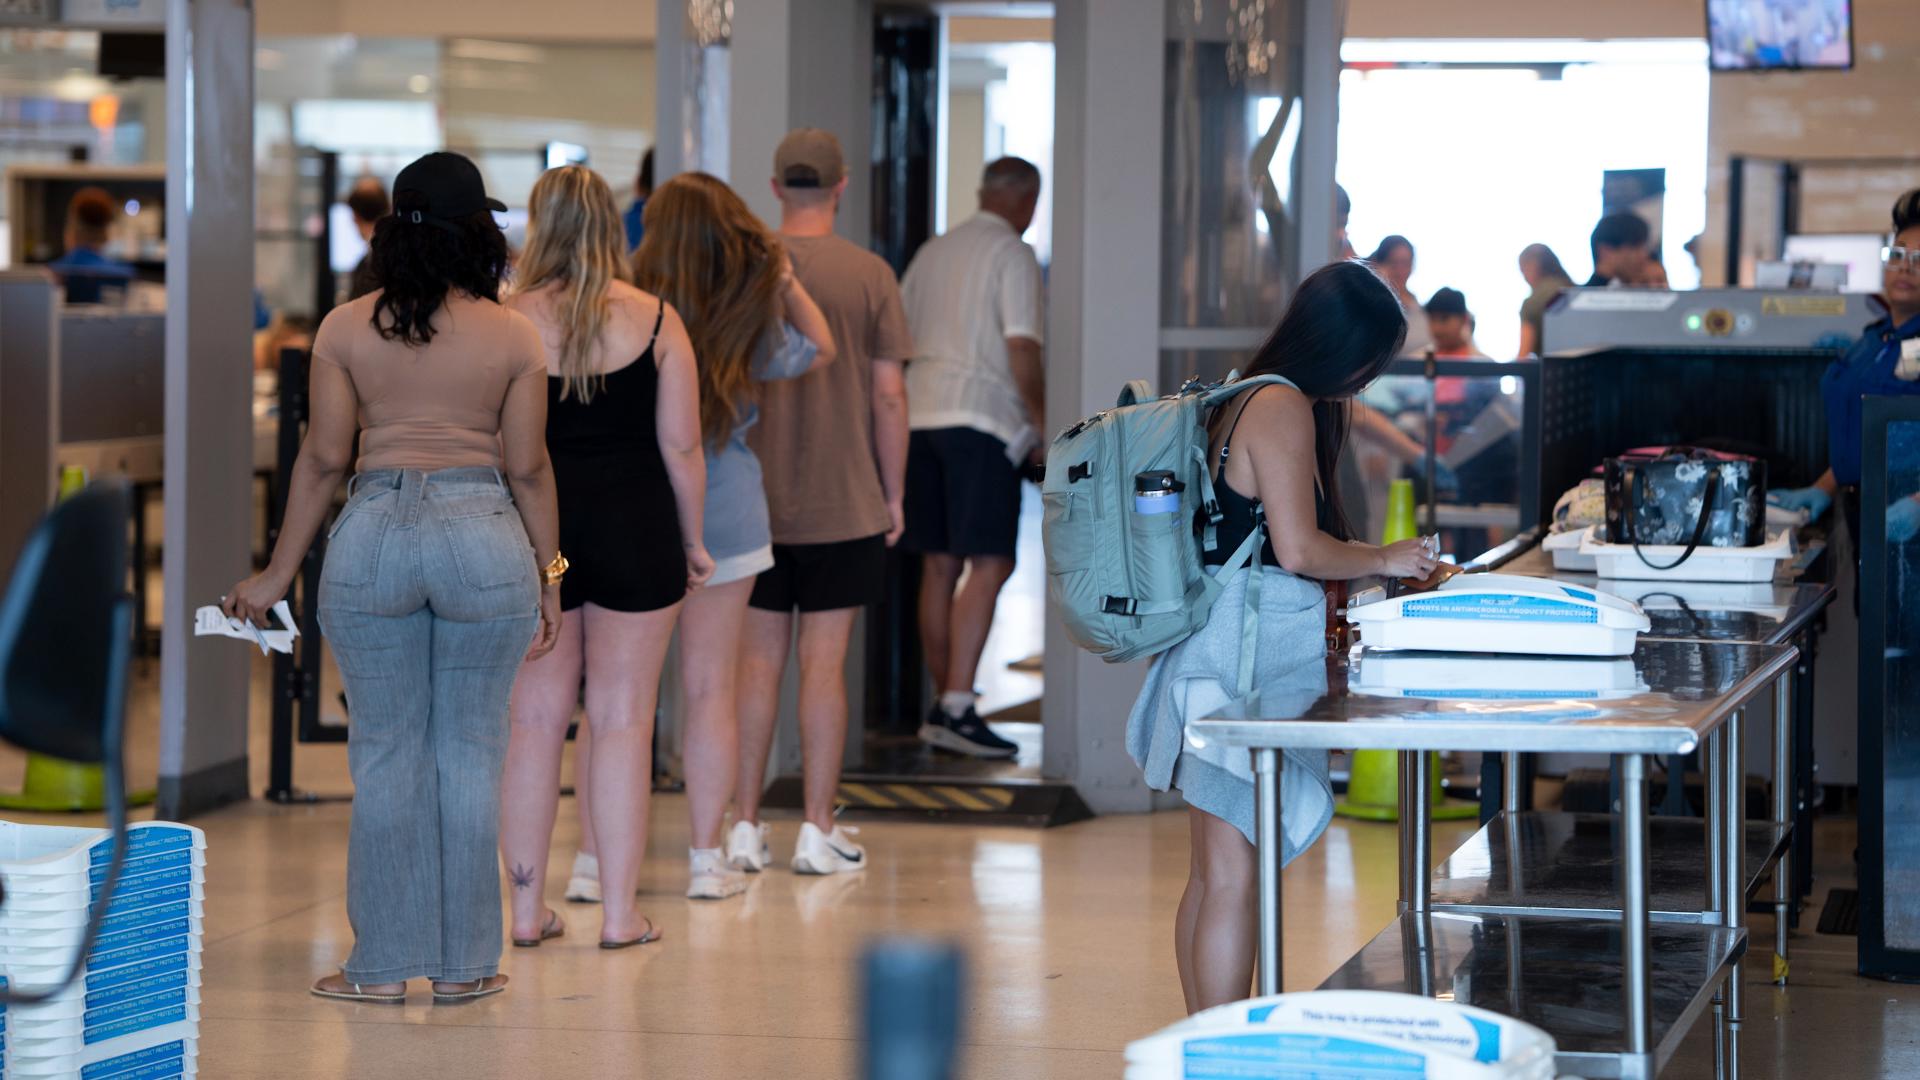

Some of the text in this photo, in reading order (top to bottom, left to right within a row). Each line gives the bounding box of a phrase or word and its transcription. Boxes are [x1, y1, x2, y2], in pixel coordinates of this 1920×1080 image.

[1509, 607, 1542, 615] PRODUCT
[1545, 608, 1592, 617] PROTECTION
[164, 834, 188, 843] PROTECTION
[162, 852, 187, 860] PROTECTION
[162, 870, 187, 879] PROTECTION
[143, 891, 161, 899] PRODUCT
[162, 886, 186, 895] PROTECTION
[161, 903, 185, 912] PROTECTION
[143, 926, 160, 935] PRODUCT
[161, 921, 185, 930] PROTECTION
[141, 943, 159, 951] PRODUCT
[160, 938, 184, 947] PROTECTION
[88, 974, 104, 982] EXPERTS
[140, 961, 159, 970] PRODUCT
[160, 955, 184, 965] PROTECTION
[87, 992, 104, 1000] EXPERTS
[140, 979, 158, 987] PRODUCT
[159, 973, 183, 983] PROTECTION
[86, 1009, 102, 1018] EXPERTS
[138, 996, 156, 1005] PRODUCT
[158, 990, 182, 1000] PROTECTION
[86, 1027, 102, 1036] EXPERTS
[138, 1014, 156, 1022] PRODUCT
[158, 1007, 182, 1017] PROTECTION
[1302, 1010, 1323, 1020] This
[1363, 1016, 1414, 1026] protected
[1419, 1019, 1440, 1028] with
[83, 1064, 100, 1072] EXPERTS
[136, 1050, 155, 1058] PRODUCT
[156, 1043, 180, 1053] PROTECTION
[155, 1060, 179, 1070] PROTECTION
